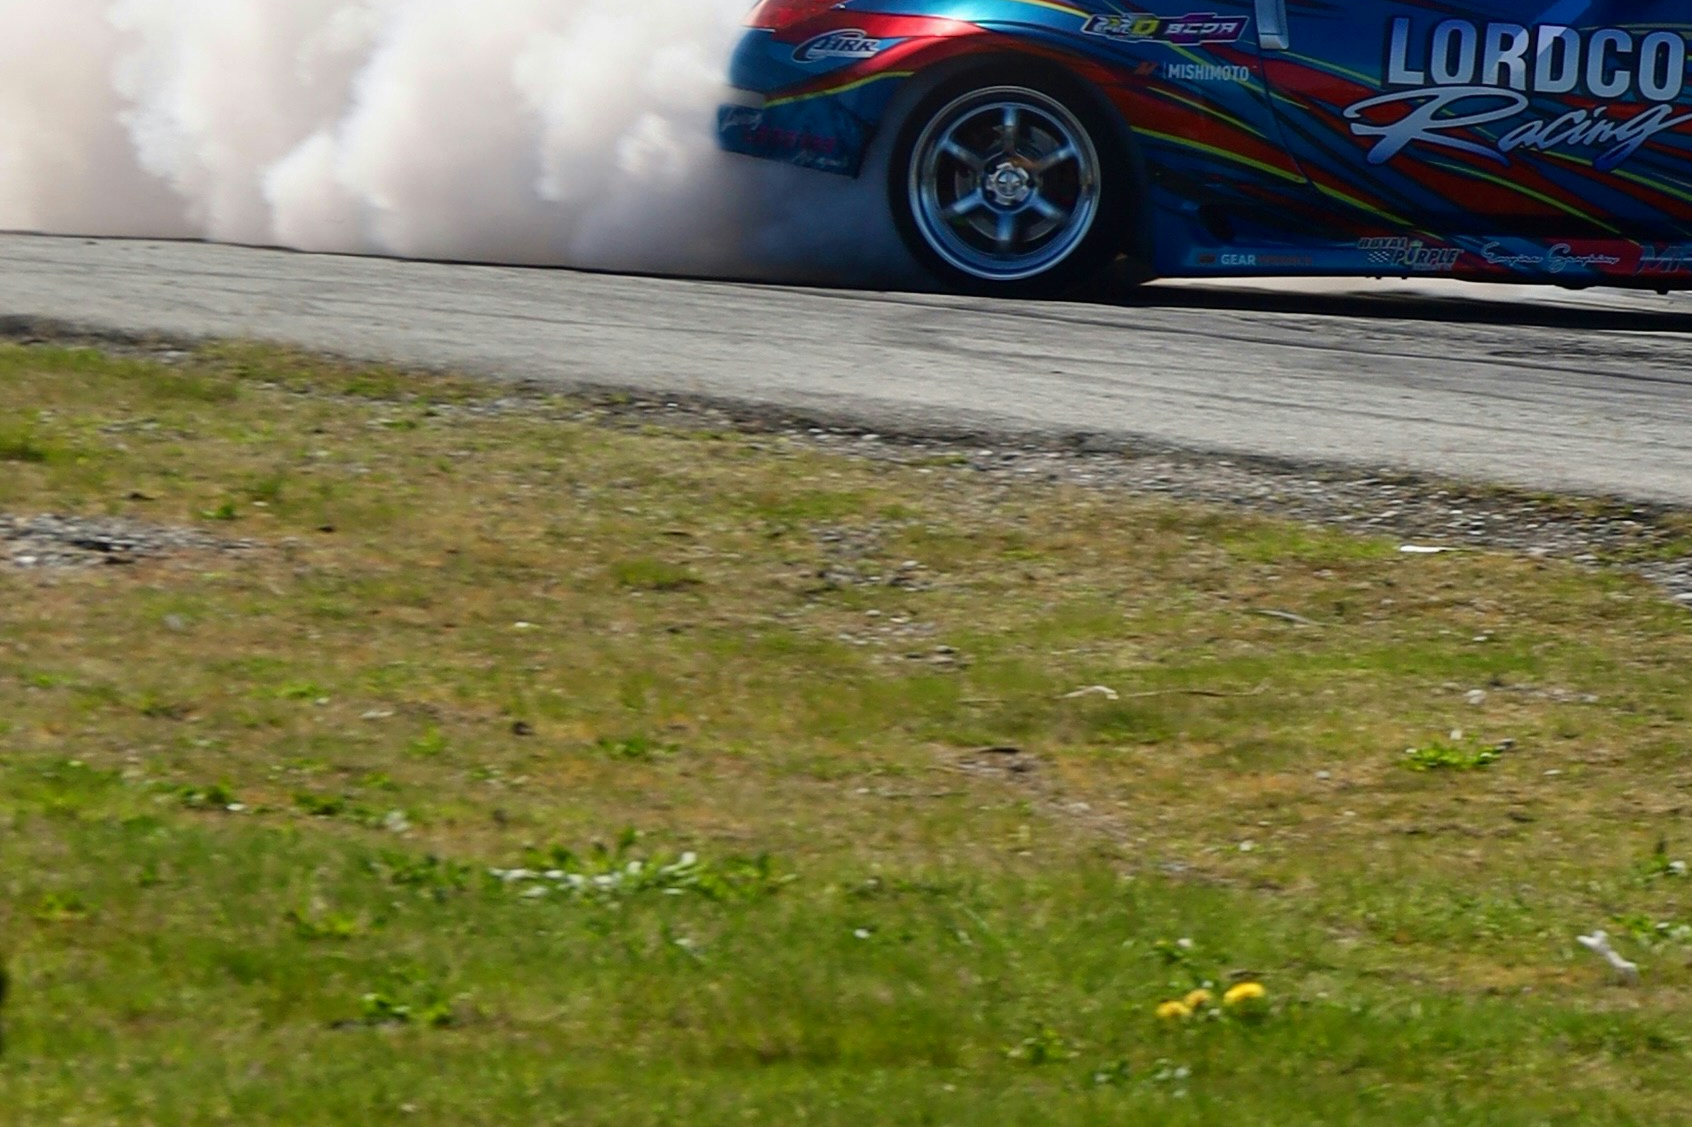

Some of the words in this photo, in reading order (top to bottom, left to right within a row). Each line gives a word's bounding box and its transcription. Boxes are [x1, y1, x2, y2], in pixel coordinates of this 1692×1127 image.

[1388, 17, 1685, 101] LORDCO
[1168, 64, 1249, 81] MISHIMOTO
[1221, 254, 1256, 266] GEAR
